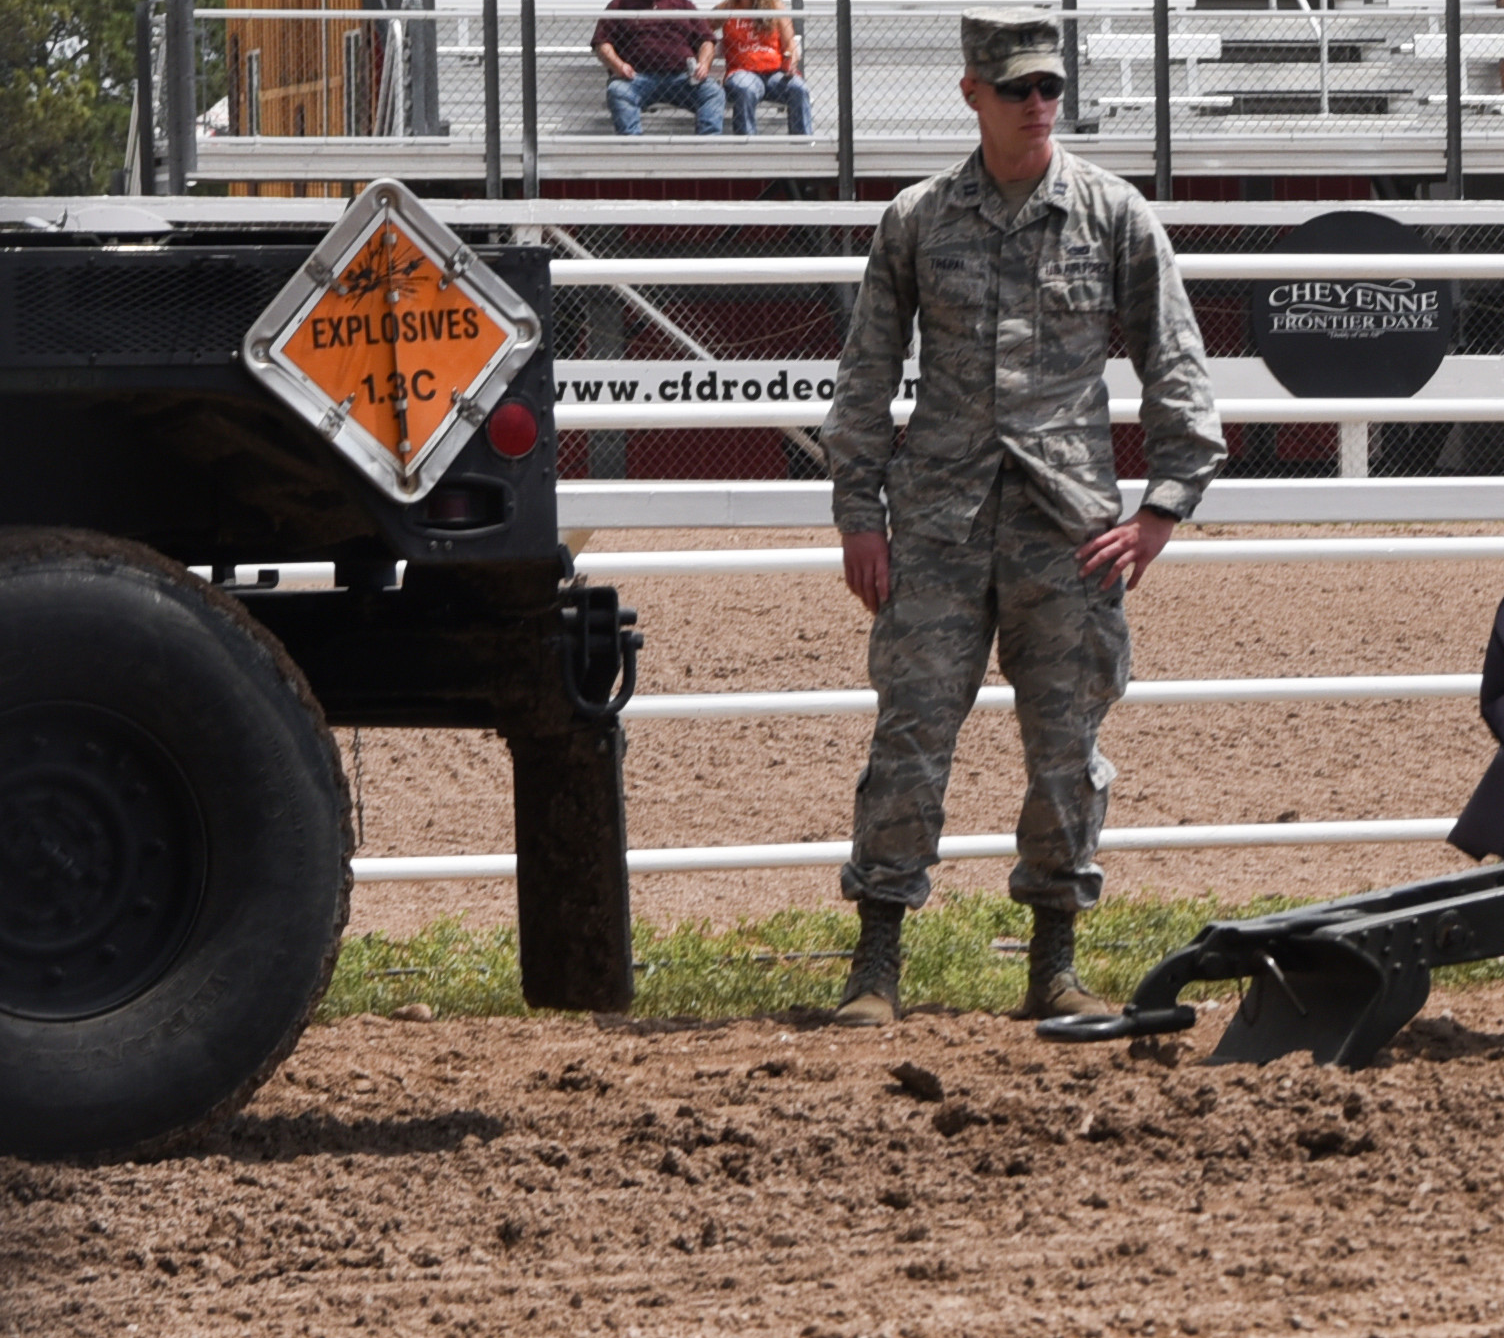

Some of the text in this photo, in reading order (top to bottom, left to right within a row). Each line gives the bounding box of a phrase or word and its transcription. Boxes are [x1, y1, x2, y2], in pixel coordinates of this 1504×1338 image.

[1268, 281, 1440, 313] CHEYENNE
[312, 308, 480, 350] EXPLOSIVES
[1272, 314, 1375, 331] FRONTIER
[360, 369, 437, 405] 1.3C
